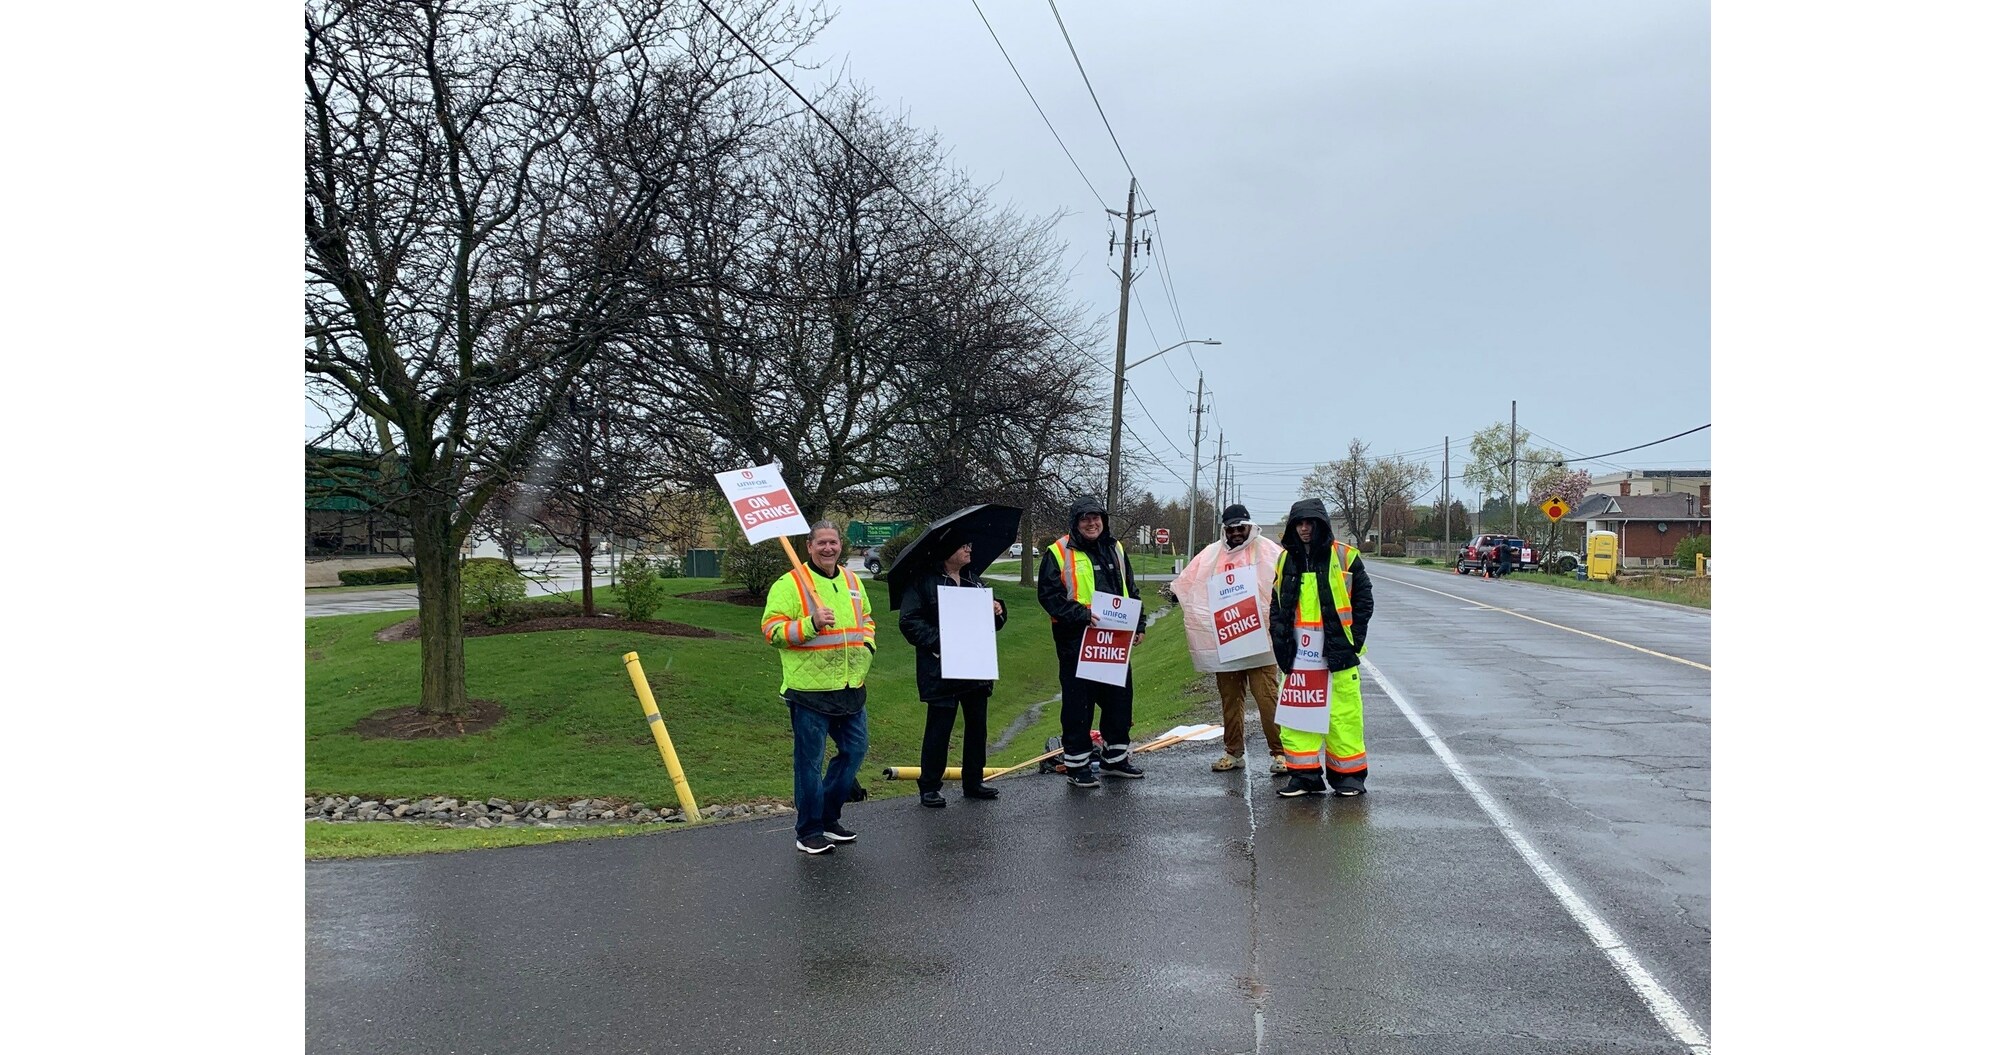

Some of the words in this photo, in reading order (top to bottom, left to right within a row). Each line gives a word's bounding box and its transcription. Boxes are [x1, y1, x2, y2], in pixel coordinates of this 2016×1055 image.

[747, 495, 770, 508] ON
[744, 503, 795, 524] STRIKE
[1220, 584, 1245, 596] UNIFOR
[1102, 609, 1127, 619] UNIFOR
[1223, 606, 1240, 623] ON
[1219, 613, 1259, 640] STRIKE
[1096, 631, 1113, 644] ON
[1085, 646, 1125, 660] STRIKE
[1289, 672, 1306, 687] ON
[1282, 689, 1324, 703] STRIKE
